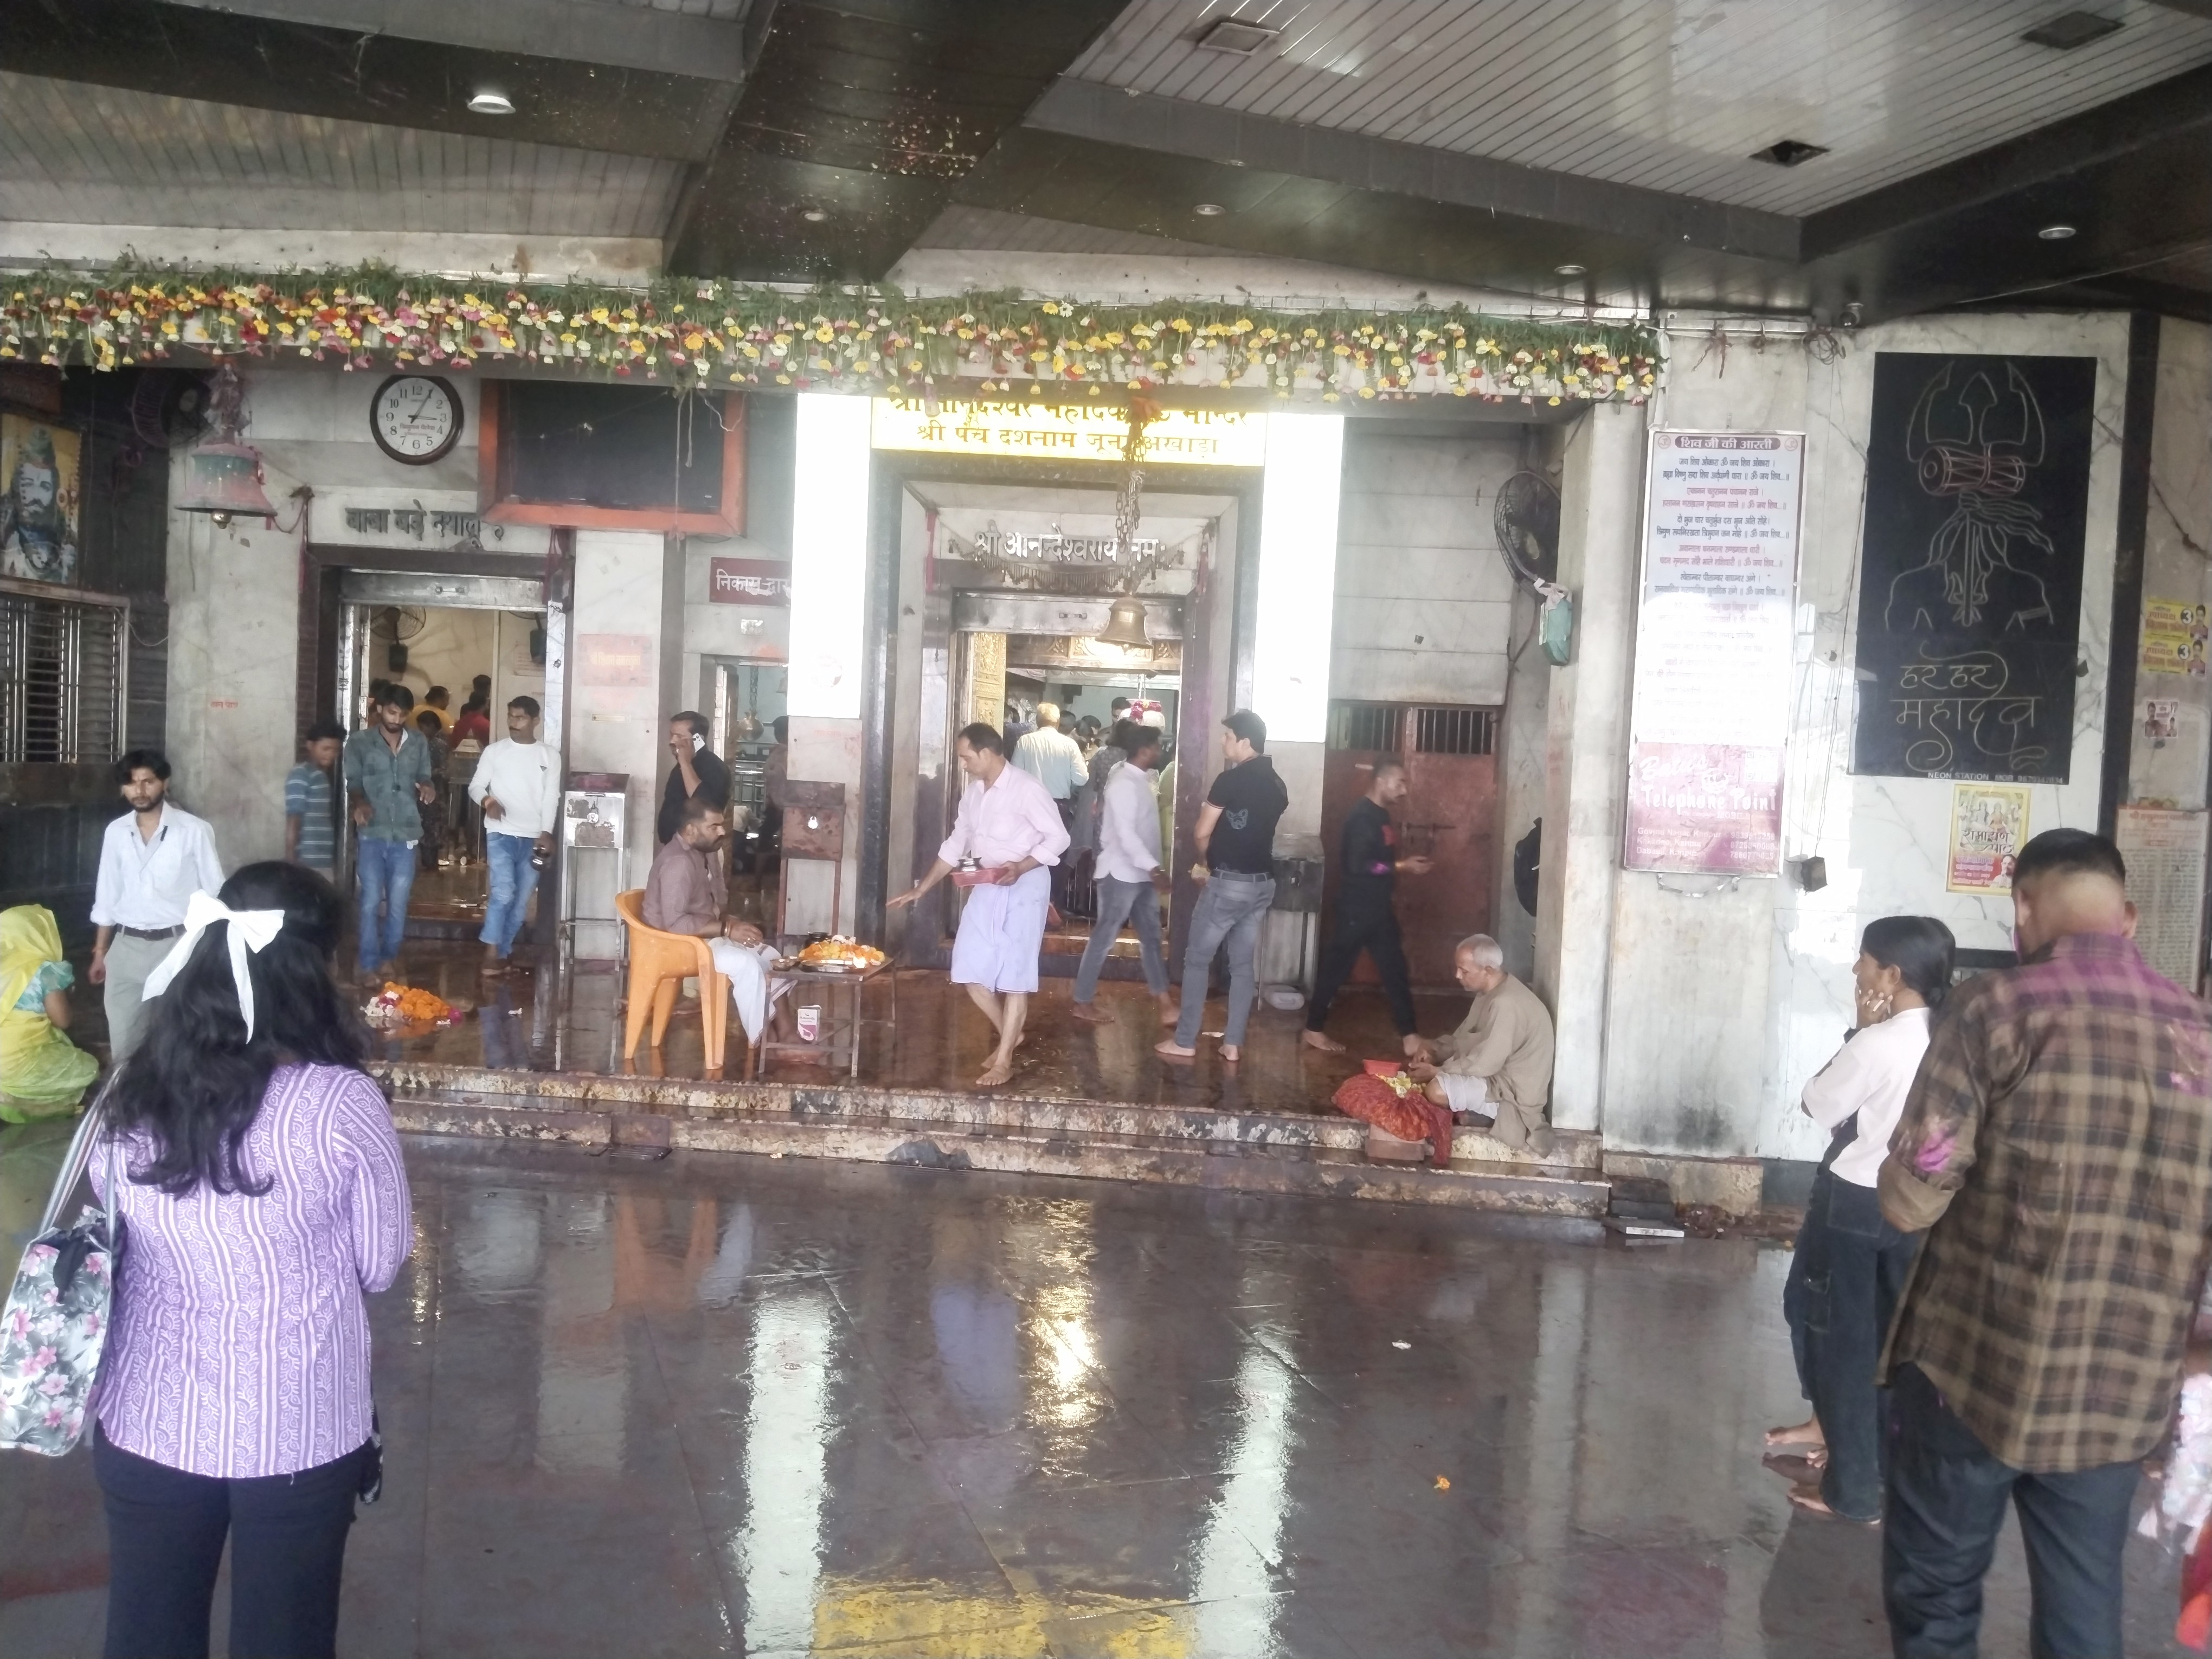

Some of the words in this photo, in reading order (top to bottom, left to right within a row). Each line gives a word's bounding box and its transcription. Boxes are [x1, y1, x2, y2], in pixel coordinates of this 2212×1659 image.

[400, 389, 407, 398] 11
[411, 385, 422, 395] 12
[390, 398, 399, 408] 10
[436, 400, 443, 409] 2
[386, 412, 394, 421] 9
[440, 413, 447, 422] 3
[390, 426, 397, 435] 8
[436, 425, 443, 434] 4
[917, 419, 947, 441] श्री
[954, 422, 991, 443] पंच
[999, 430, 1078, 448] दशनाम
[400, 436, 407, 445] 7
[412, 440, 421, 449] 6
[426, 436, 433, 446] 5
[1681, 436, 1702, 448] शिव
[1705, 438, 1719, 449] जी
[1721, 438, 1737, 449] की
[1740, 438, 1772, 449] आरती
[1690, 456, 1700, 466] शिव
[1741, 456, 1751, 467] शिव
[1700, 469, 1709, 479] शिव
[346, 507, 391, 533] बाबा
[974, 531, 1000, 556] श्री
[2182, 609, 2191, 624] 3
[2179, 645, 2189, 659] 3
[1900, 665, 1948, 689] हर
[1949, 665, 1998, 689] हर
[1927, 771, 1952, 780] NEON
[1954, 773, 1989, 781] STATION
[1641, 785, 1726, 815] Telephone
[1729, 788, 1776, 811] Point
[1637, 827, 1664, 835] Govind
[1961, 830, 2011, 843] रामायण
